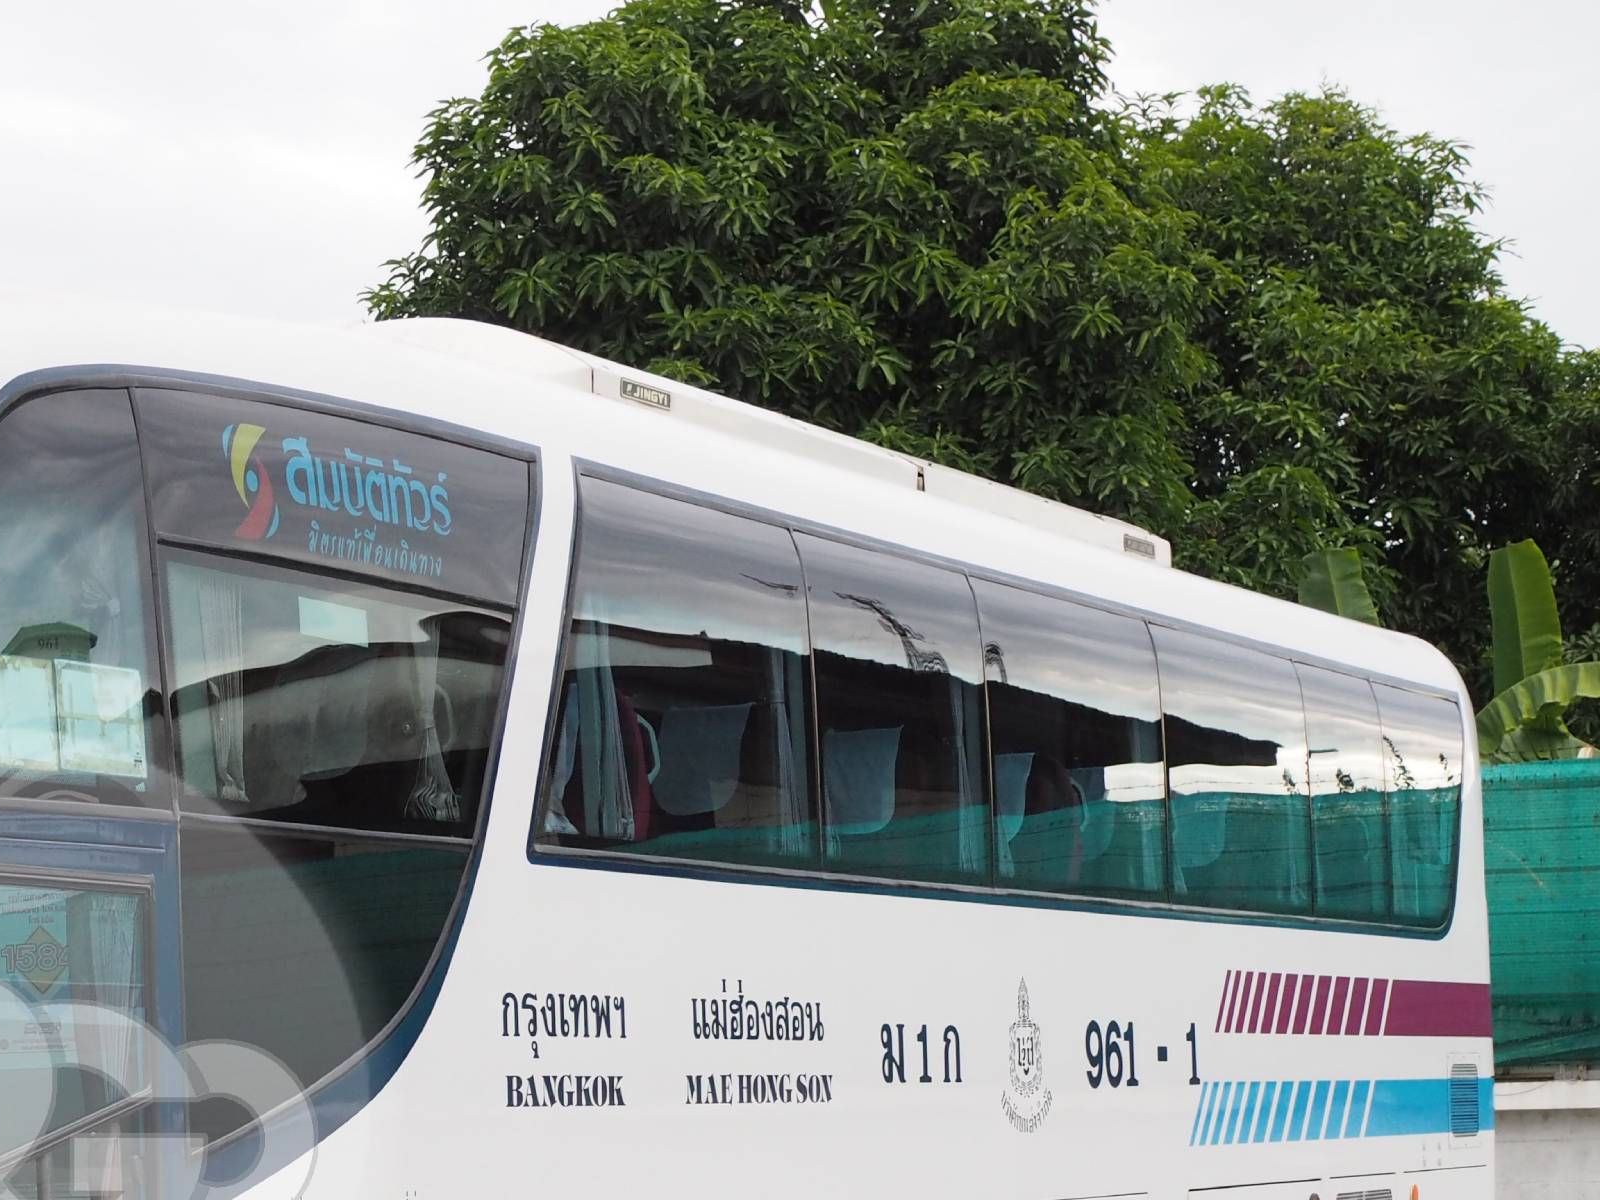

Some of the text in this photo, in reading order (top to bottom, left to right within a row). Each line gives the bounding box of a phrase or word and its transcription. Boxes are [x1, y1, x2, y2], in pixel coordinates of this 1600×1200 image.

[633, 386, 668, 406] JINGYI
[281, 437, 452, 536] สมบัติทัวร์
[501, 991, 628, 1058] กรุงเทพฯ
[691, 979, 825, 1042] แม่ฮ่องสอน
[505, 1074, 627, 1108] BANGKOK
[685, 1074, 833, 1105] MAE HONG SON
